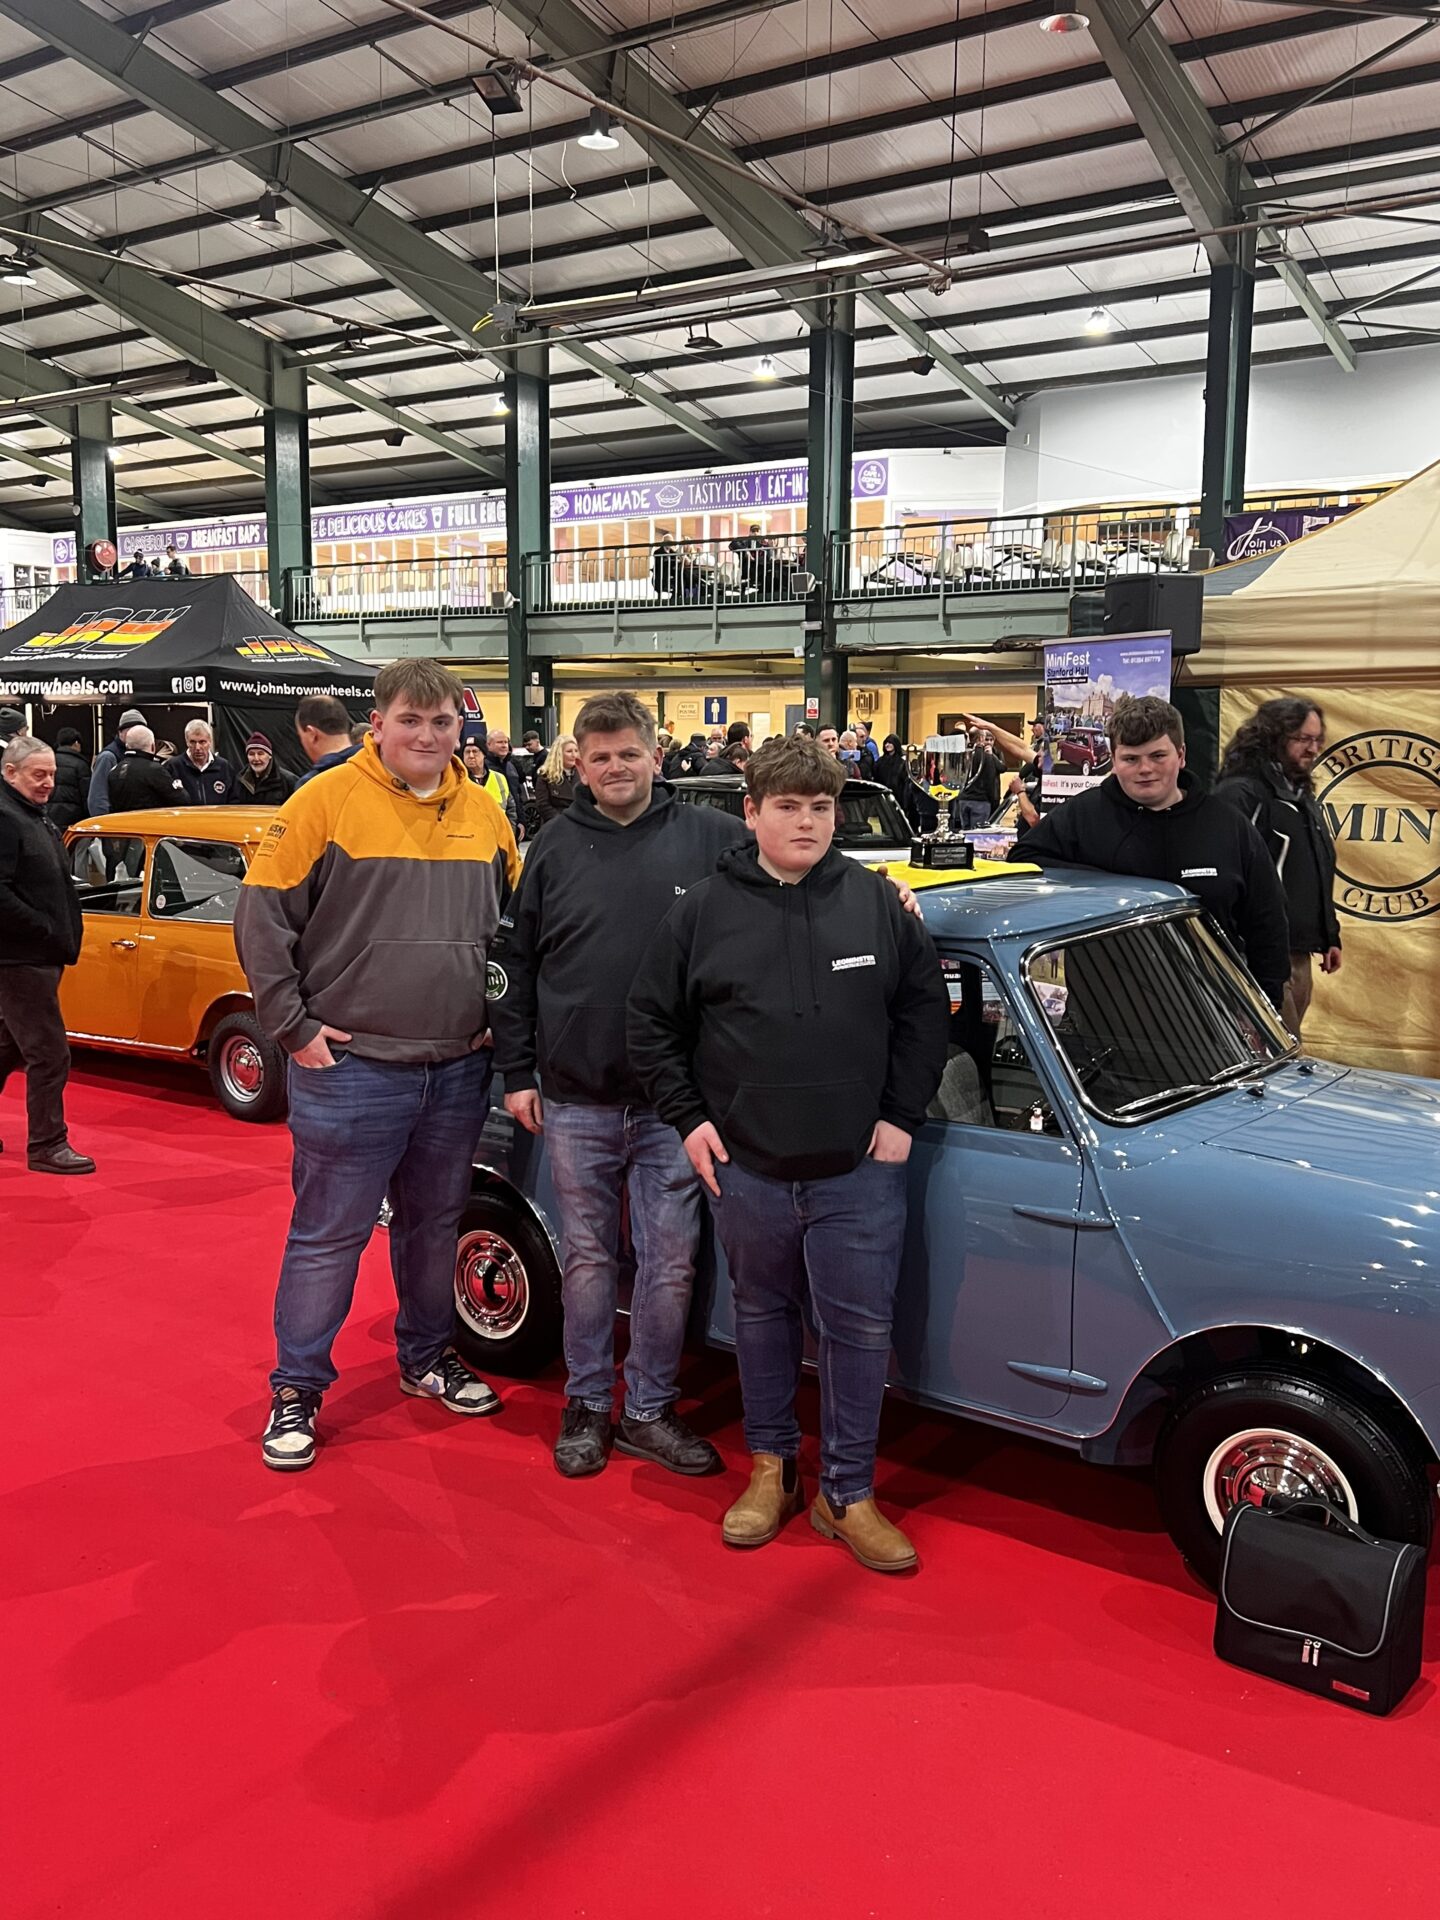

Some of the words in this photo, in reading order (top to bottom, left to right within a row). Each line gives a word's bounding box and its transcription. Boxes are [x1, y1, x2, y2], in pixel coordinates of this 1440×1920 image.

[574, 489, 651, 515] HOMEMADE
[688, 482, 721, 505] TASTY
[725, 478, 749, 502] PIES
[768, 472, 803, 498] EAT-IN
[327, 511, 386, 537] DELICIOUS
[387, 508, 428, 532] CAKES
[447, 504, 477, 526] FULL
[123, 533, 173, 554] CASSEROLE
[191, 526, 237, 548] BREAKFAST
[237, 524, 260, 544] BAPS
[1270, 539, 1282, 548] us
[1046, 651, 1091, 668] MiniFest
[1047, 669, 1074, 678] Stanford
[1075, 667, 1090, 676] Hall
[1342, 886, 1430, 915] CLUB
[831, 954, 875, 967] LEOMINSTER
